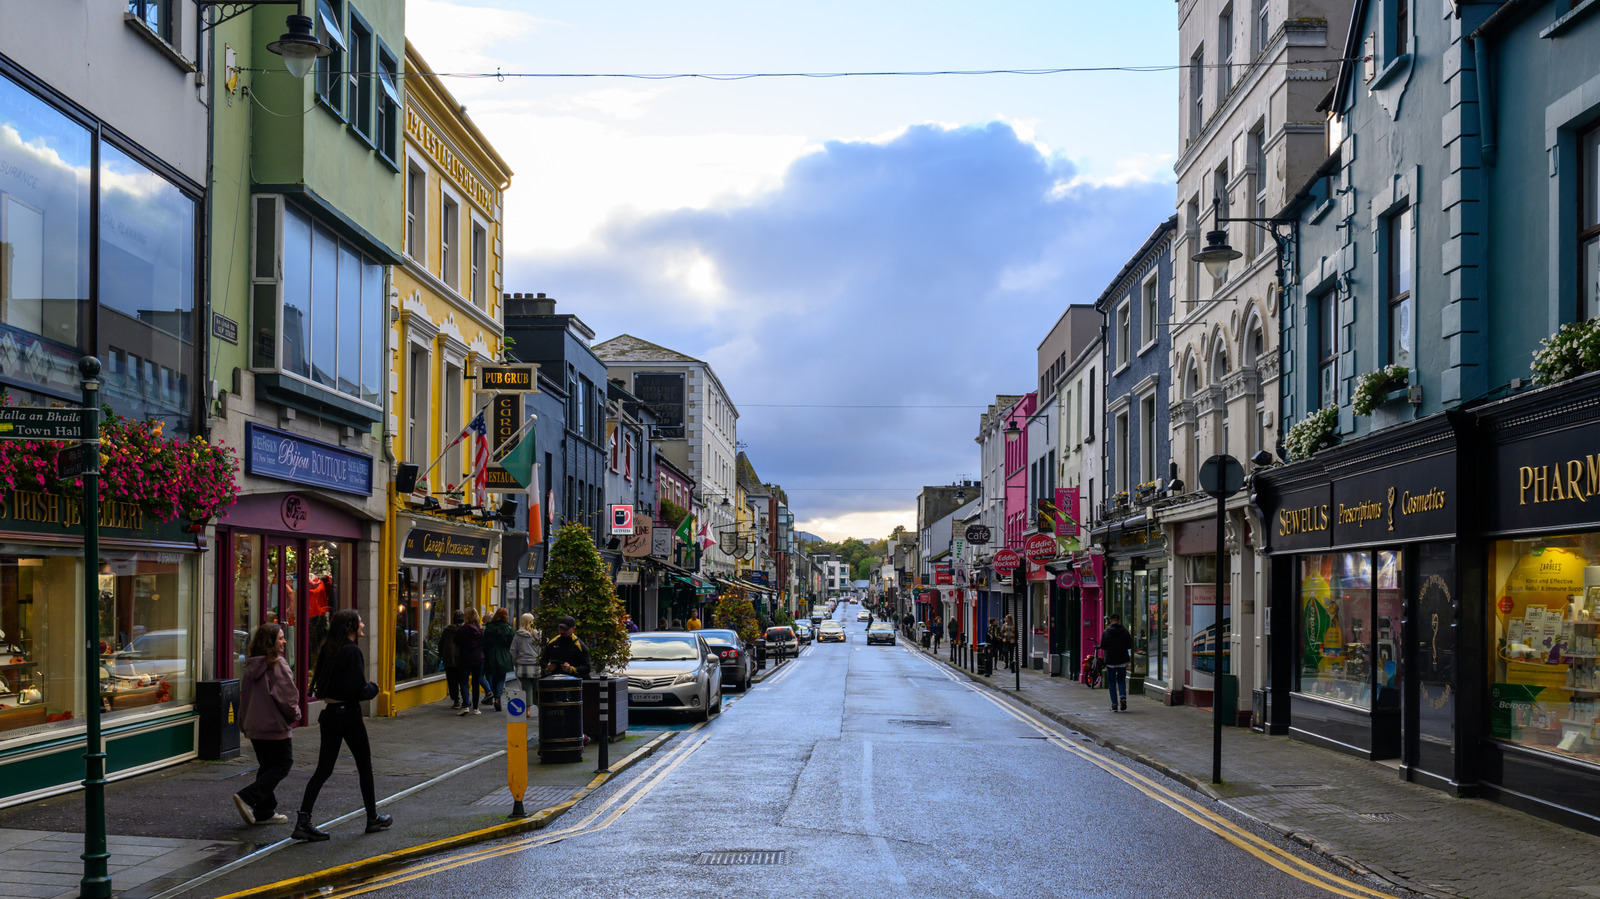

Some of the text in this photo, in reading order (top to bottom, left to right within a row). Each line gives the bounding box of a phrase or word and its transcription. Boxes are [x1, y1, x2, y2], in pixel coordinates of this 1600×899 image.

[485, 372, 529, 384] PUB GRUB
[29, 413, 43, 421] an
[46, 411, 81, 422] Bhaile
[15, 424, 81, 436] Town Hall
[278, 438, 347, 483] Bijou BOUTIQUE
[487, 471, 518, 484] ESTAUR
[1519, 453, 1600, 506] PHARM
[13, 489, 59, 523] IRISH
[61, 495, 143, 530] JEELLERY
[1279, 487, 1446, 536] SEWELLS Prescriptions Cosmetics
[967, 530, 989, 540] café
[1026, 544, 1057, 556] Rocket's
[1030, 539, 1052, 549] Eddie
[994, 559, 1020, 567] Rocket's
[1499, 700, 1531, 709] Berocca
